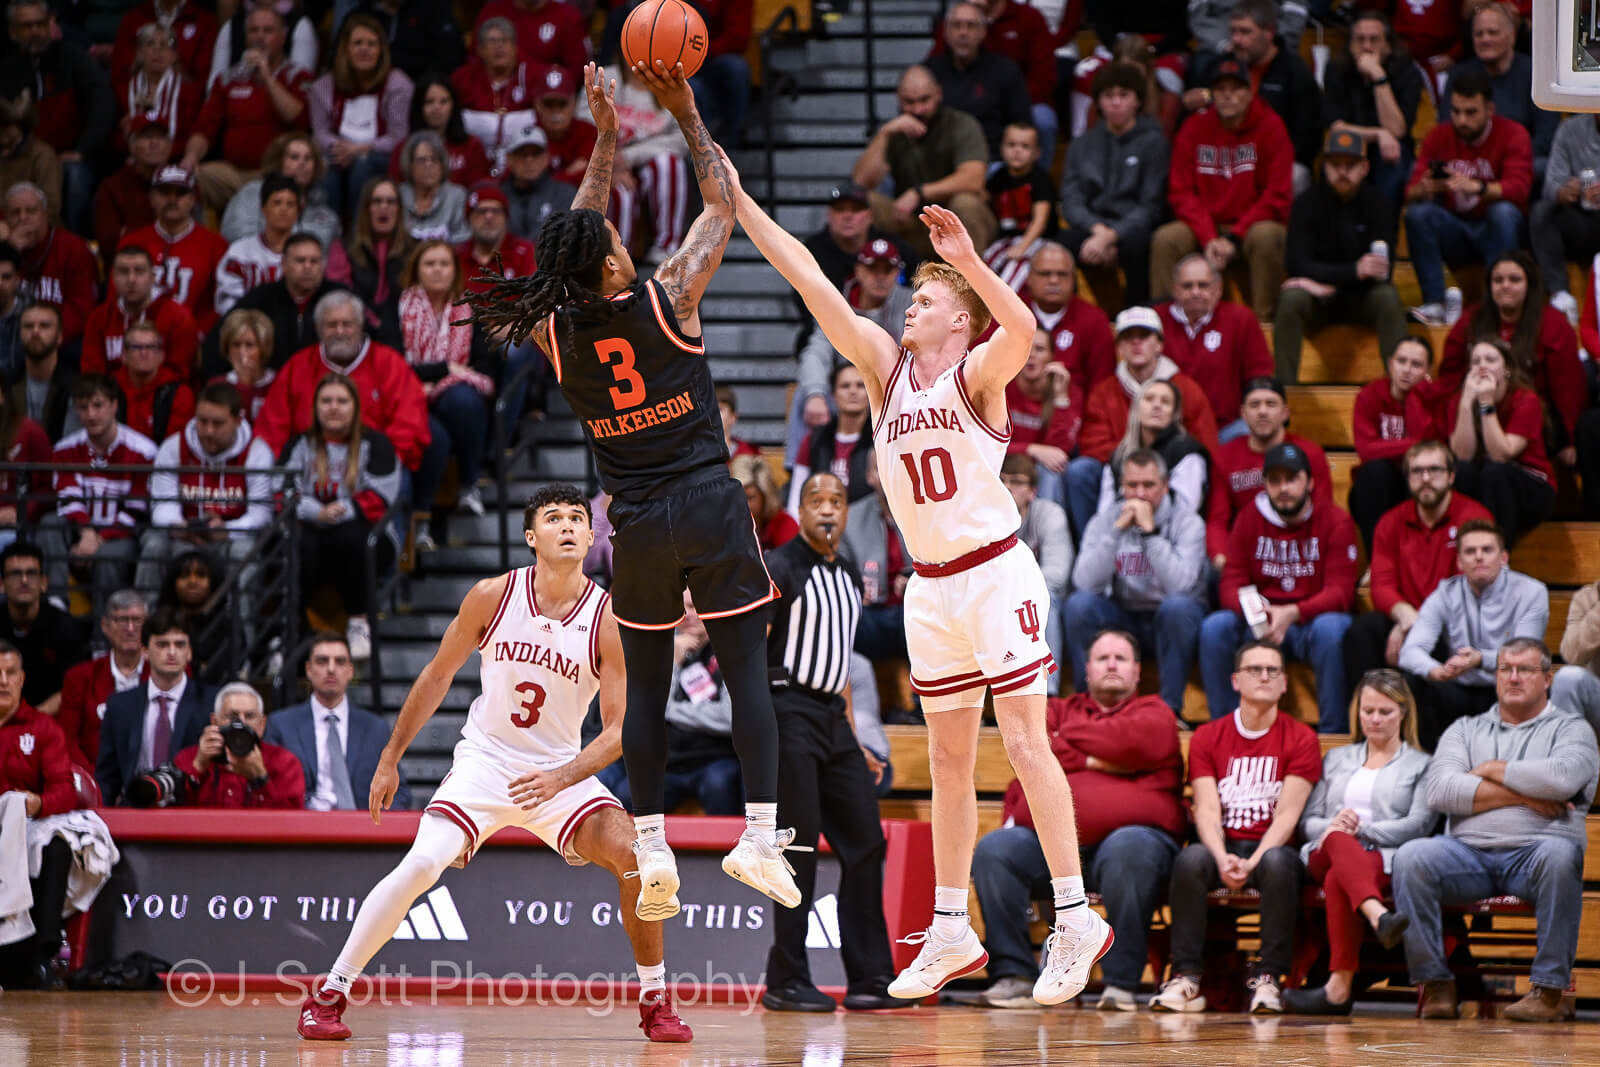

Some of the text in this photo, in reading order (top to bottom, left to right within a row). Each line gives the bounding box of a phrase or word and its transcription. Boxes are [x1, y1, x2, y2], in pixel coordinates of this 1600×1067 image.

[593, 337, 647, 411] 3
[587, 391, 695, 438] WILKERSON
[899, 446, 958, 504] 10
[495, 641, 580, 685] INDIANA
[510, 681, 547, 729] 3
[122, 893, 356, 921] YOU GOT THI
[505, 900, 573, 926] YOU
[682, 904, 764, 930] THIS
